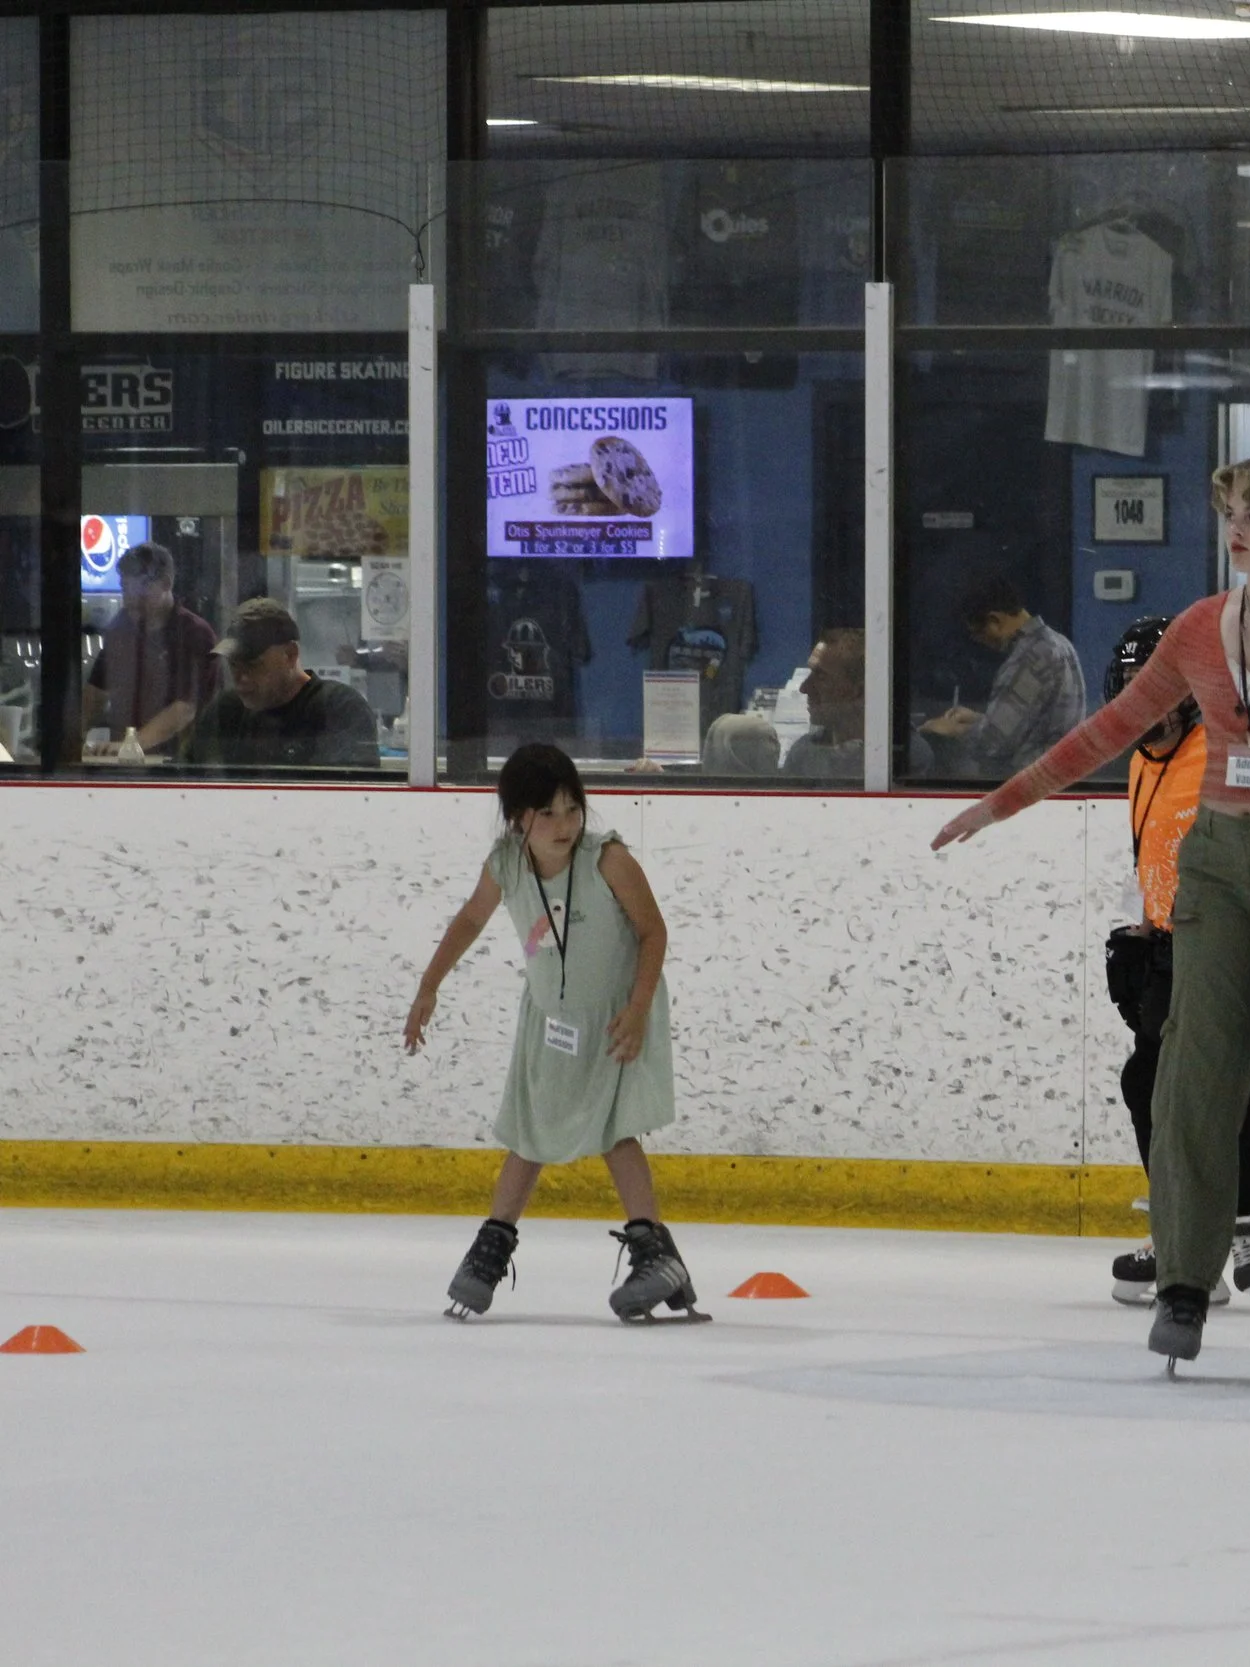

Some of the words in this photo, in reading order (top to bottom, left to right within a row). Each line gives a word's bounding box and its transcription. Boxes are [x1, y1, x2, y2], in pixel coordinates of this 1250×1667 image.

[275, 361, 336, 380] FIGURE
[82, 415, 166, 431] CENTER
[525, 405, 667, 431] CONCESSIONS
[487, 467, 536, 499] TEM!
[271, 473, 367, 533] PIZZA
[1114, 500, 1144, 524] 1048
[507, 524, 530, 538] Otis
[535, 524, 602, 543] Spunkmeyer
[606, 524, 650, 538] Cookies
[534, 542, 550, 554] for
[572, 544, 585, 554] or
[601, 542, 616, 554] for
